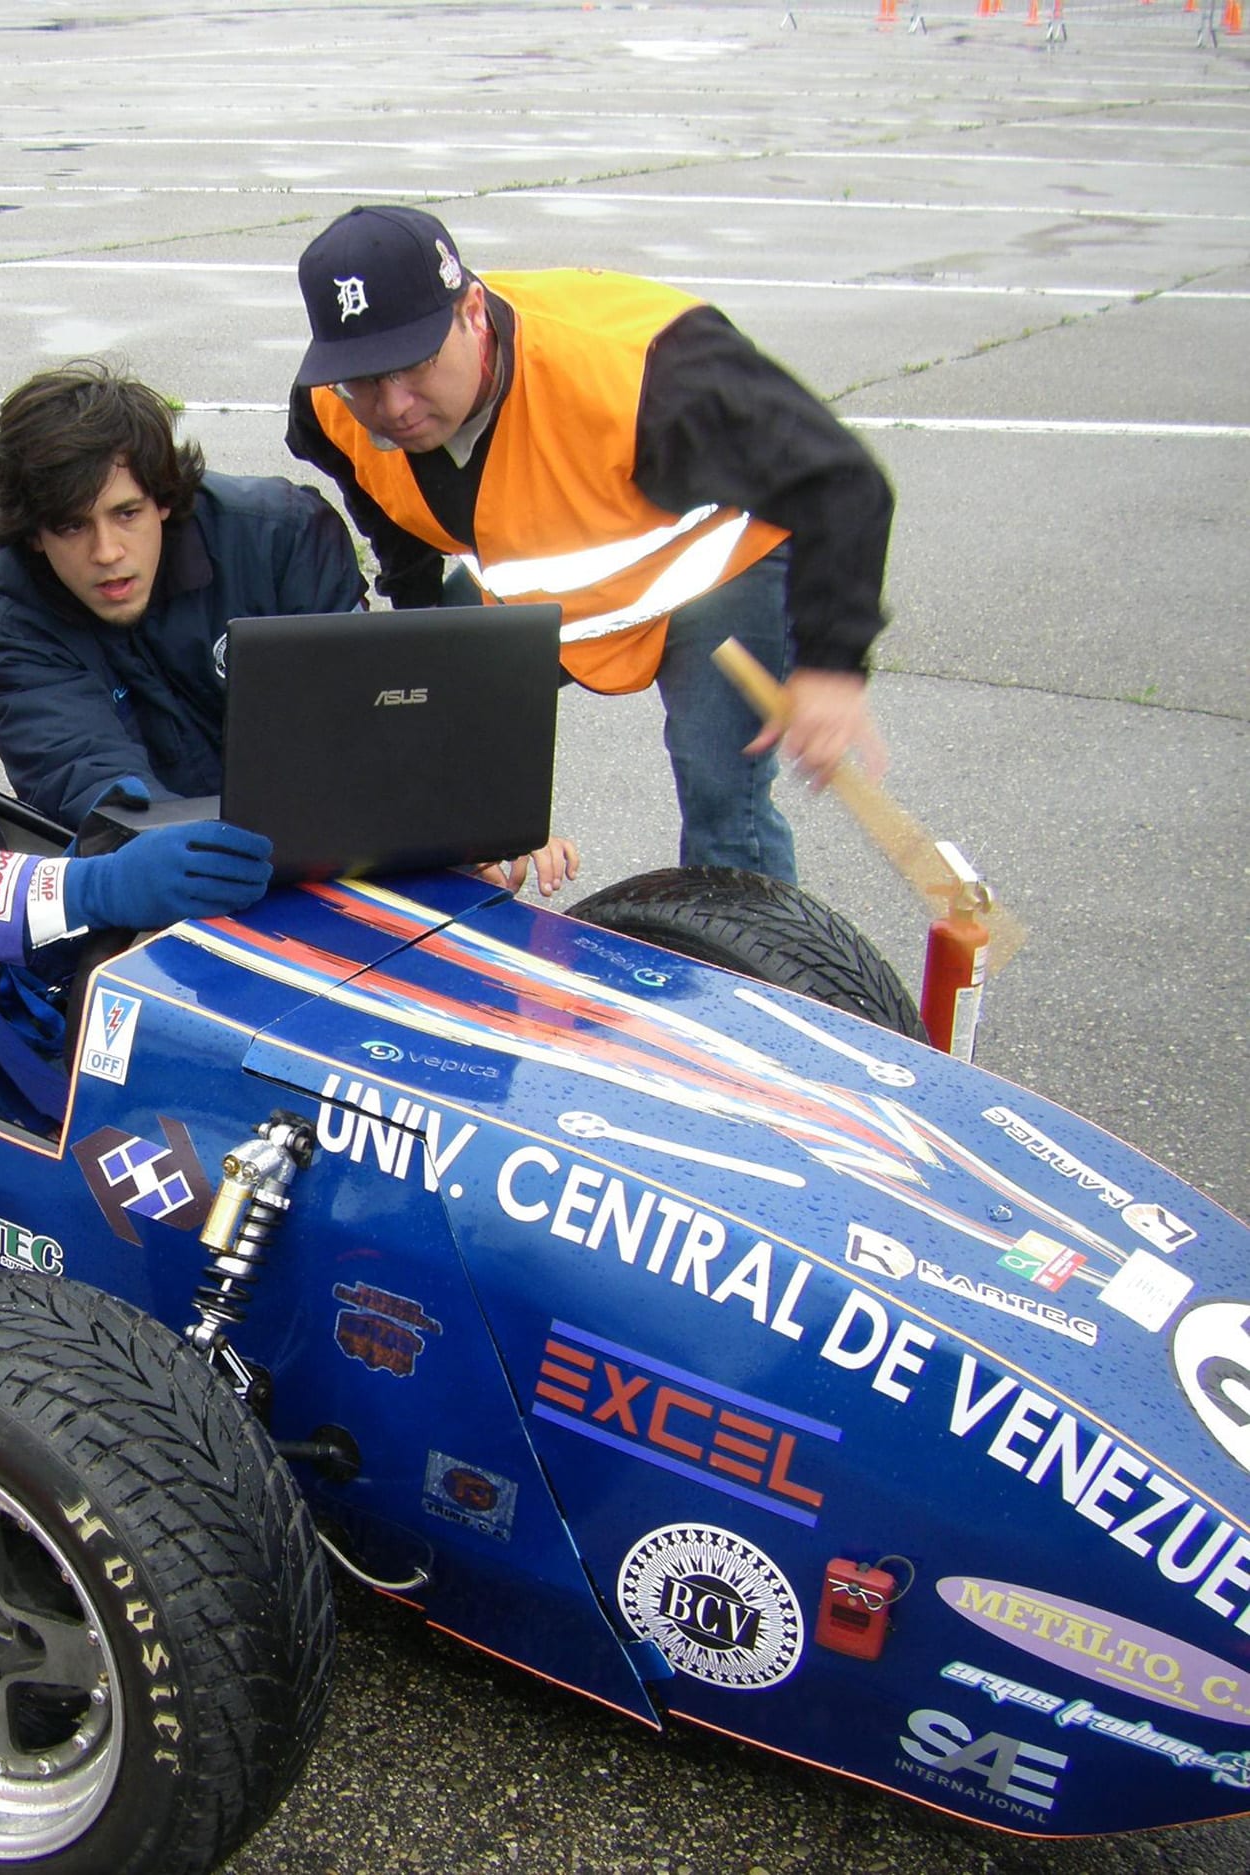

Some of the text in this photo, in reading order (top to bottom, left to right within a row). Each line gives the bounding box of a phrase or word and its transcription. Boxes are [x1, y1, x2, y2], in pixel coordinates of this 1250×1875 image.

[333, 276, 369, 323] D
[374, 688, 428, 706] ASUS
[41, 865, 56, 901] OMP
[91, 1054, 120, 1074] OFF
[409, 1051, 499, 1078] vepica
[983, 1108, 1128, 1207] KARTEC
[920, 1261, 1096, 1342] KARTEC
[316, 1073, 478, 1199] UNIV.
[496, 1146, 814, 1341] CENTRAL
[819, 1288, 938, 1403] DE
[949, 1353, 1250, 1636] VENEZUE
[535, 1340, 823, 1507] EXCEL
[668, 1579, 756, 1645] BCV
[955, 1579, 1186, 1694] METALTO,
[942, 1662, 1203, 1765] argos trading
[894, 1758, 1047, 1824] INTERNATIONAL
[900, 1709, 1068, 1810] SAE
